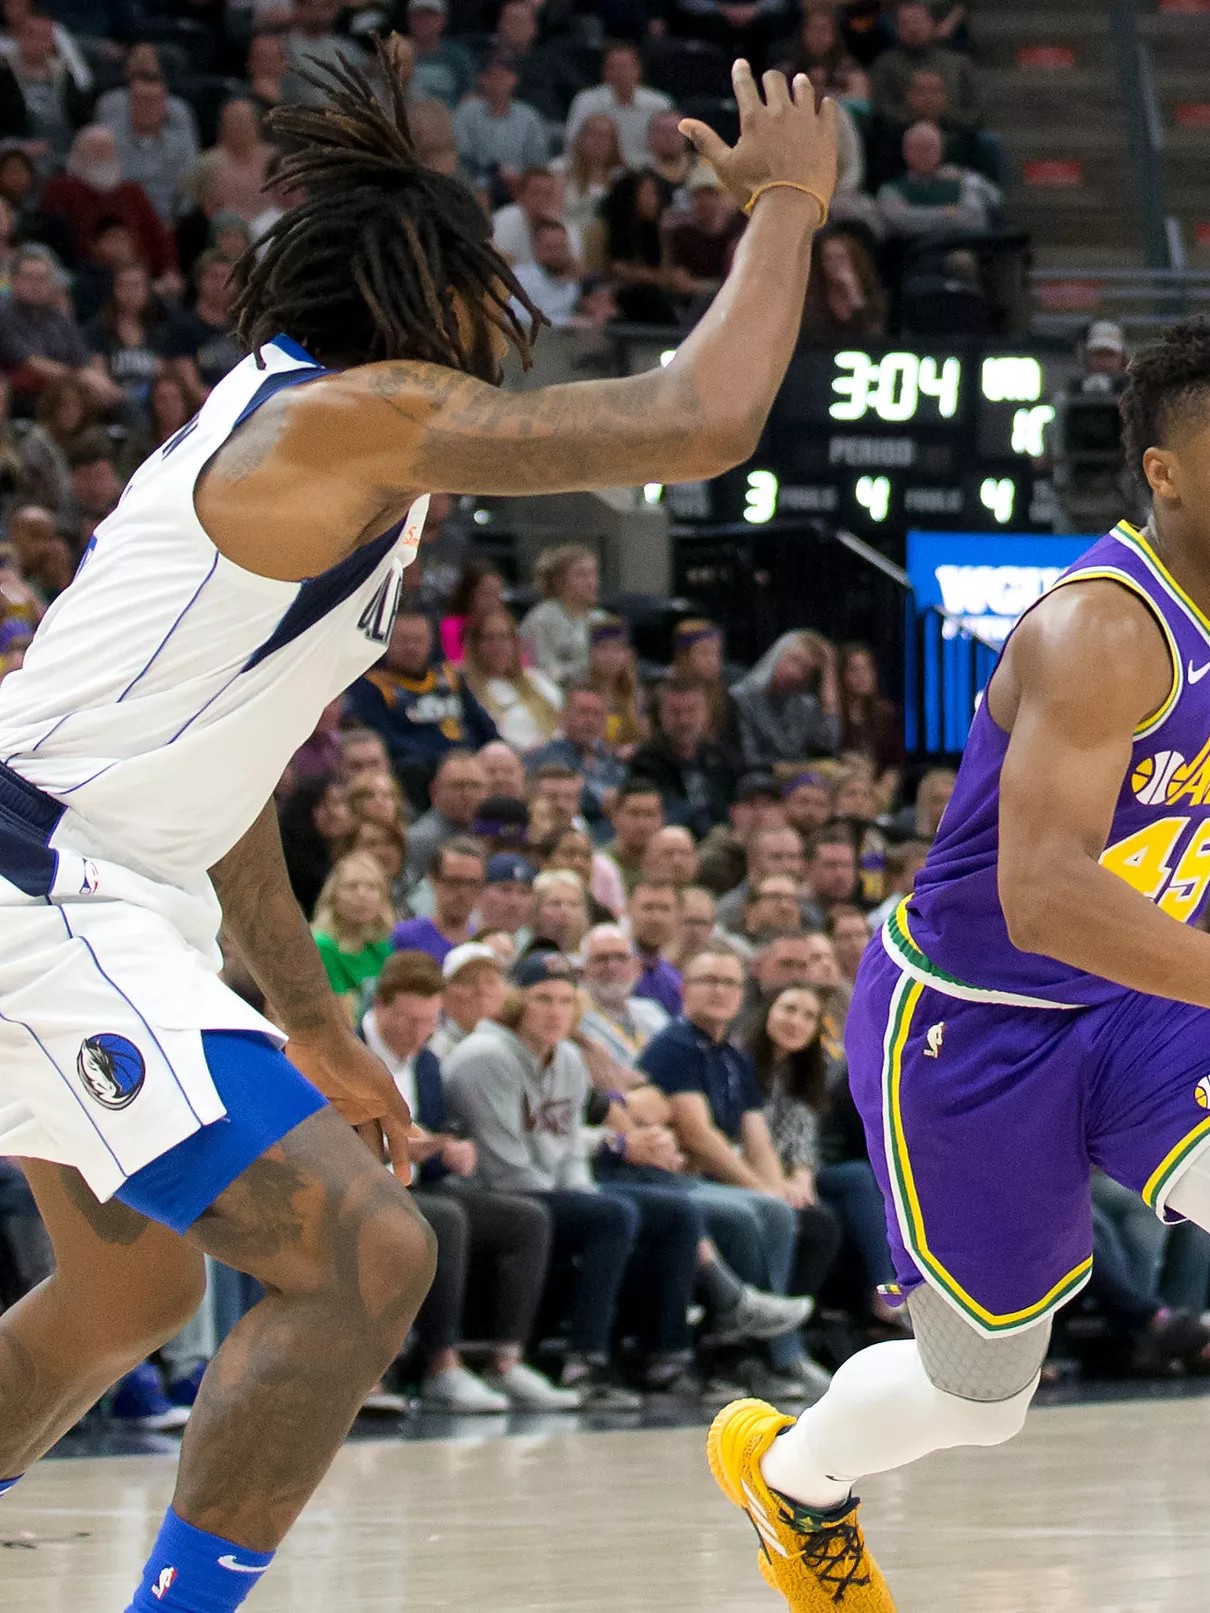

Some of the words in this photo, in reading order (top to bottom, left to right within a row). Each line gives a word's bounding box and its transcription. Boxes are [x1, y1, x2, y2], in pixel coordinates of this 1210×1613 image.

[829, 351, 961, 421] 3:04
[743, 470, 778, 524] 3
[855, 475, 891, 523] 4
[980, 477, 1015, 524] 4
